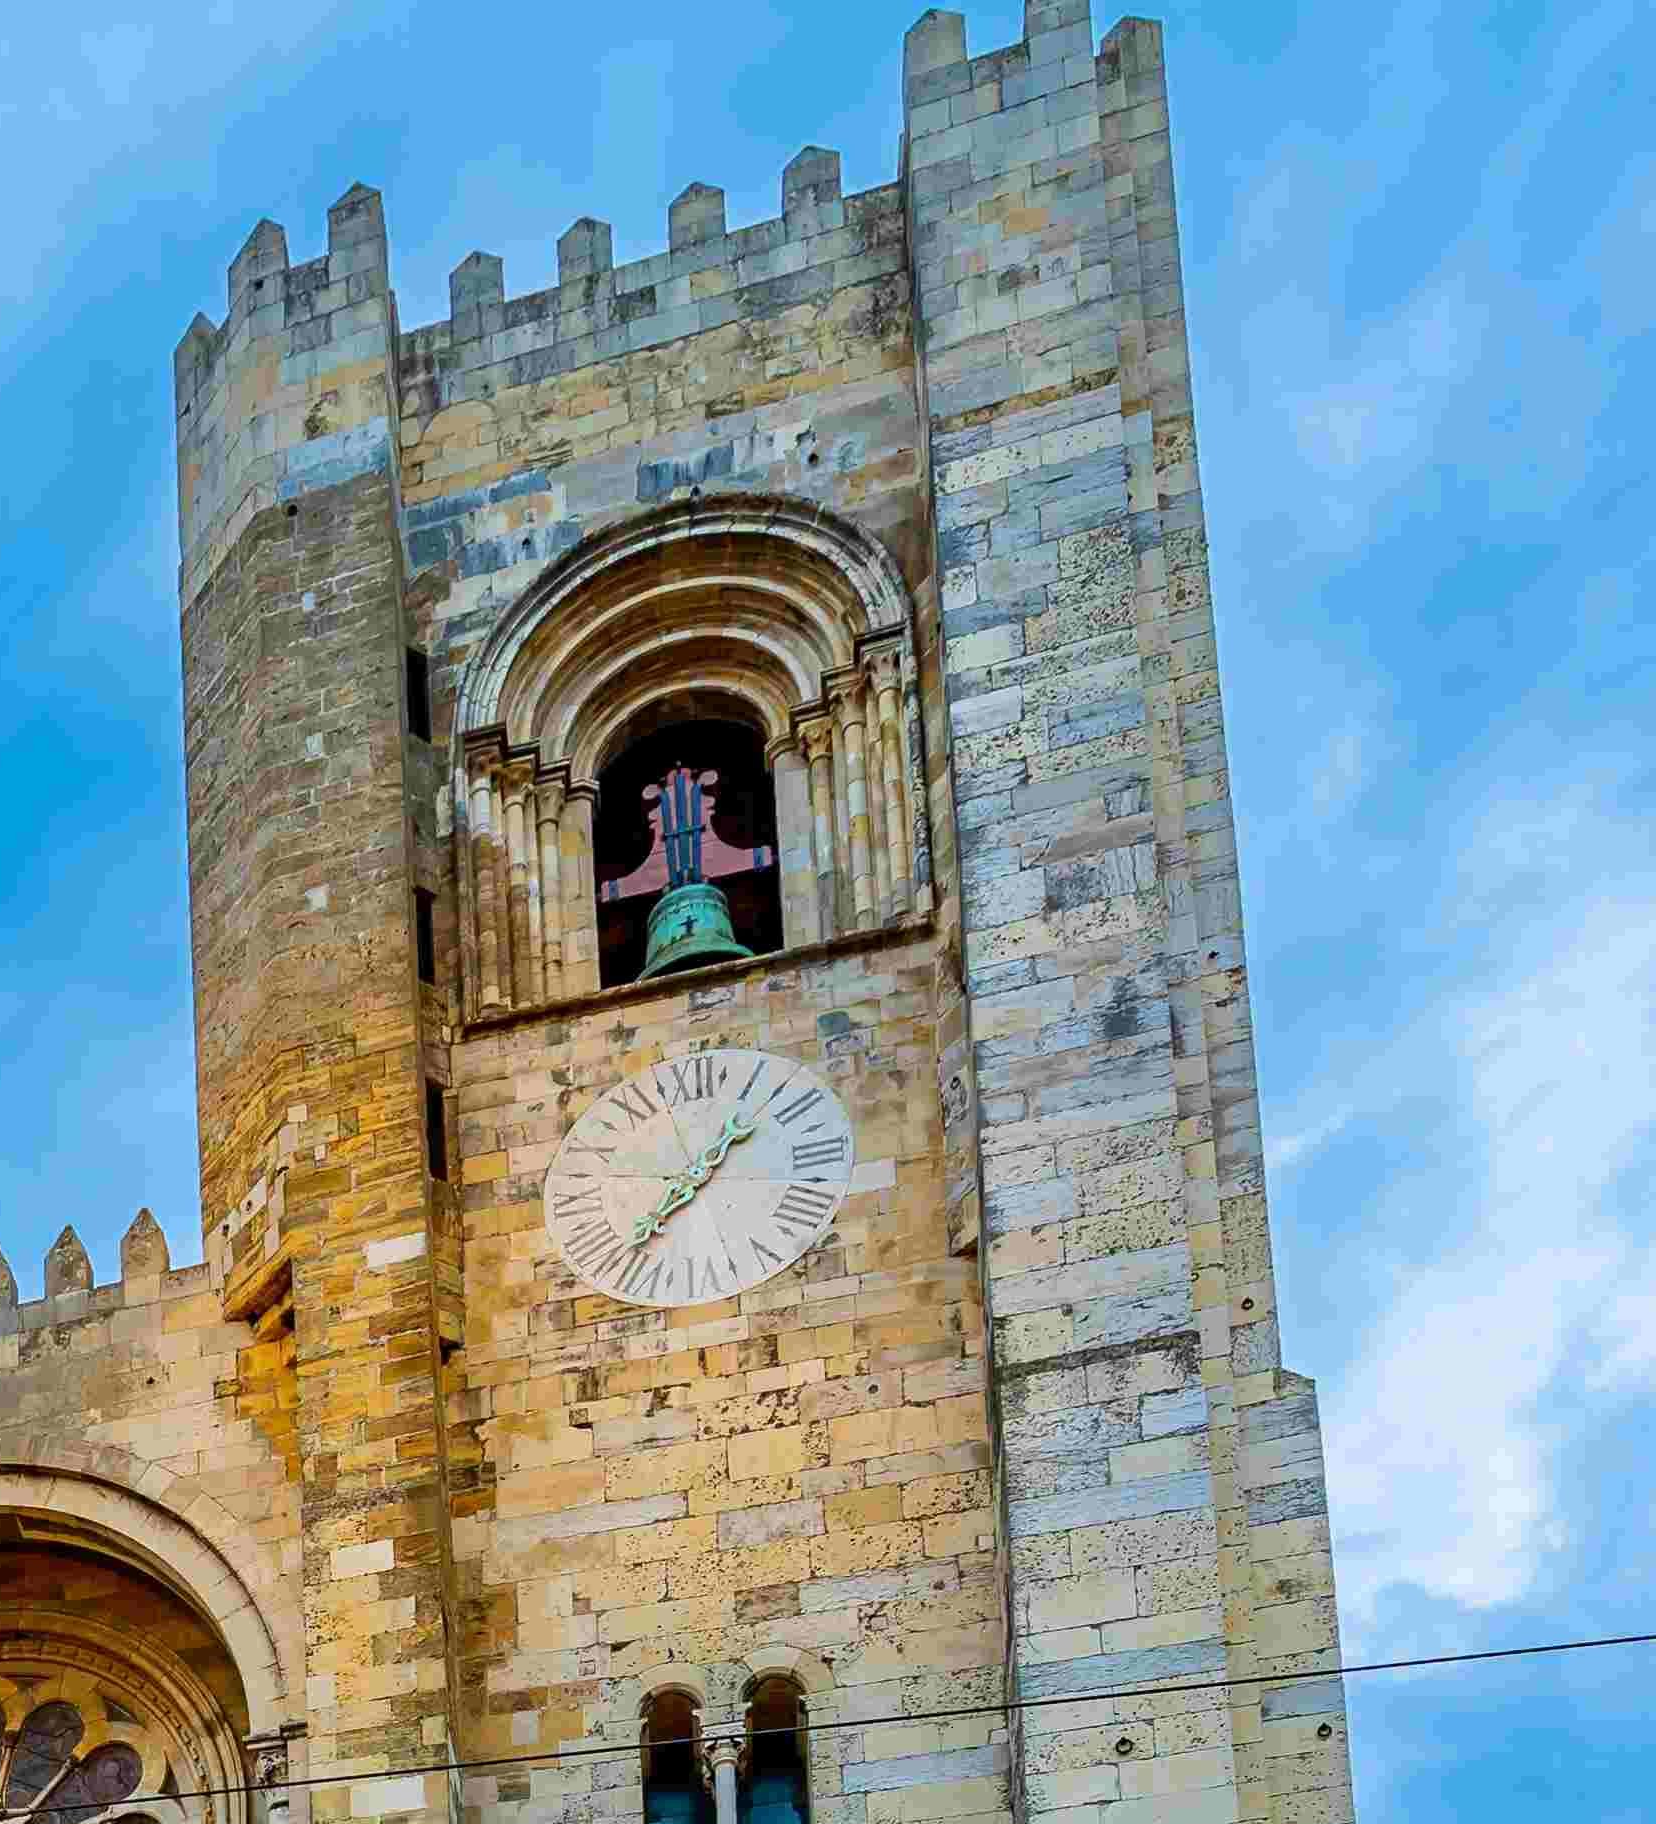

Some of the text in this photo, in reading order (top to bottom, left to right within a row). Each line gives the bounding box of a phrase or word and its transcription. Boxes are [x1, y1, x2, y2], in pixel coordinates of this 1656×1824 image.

[672, 1056, 714, 1104] XII
[738, 1060, 769, 1101] I
[609, 1083, 658, 1131] XI
[772, 1087, 824, 1127] II
[565, 1136, 616, 1164] X
[792, 1136, 849, 1171] III
[553, 1187, 602, 1219] IX
[611, 1246, 666, 1298] VII
[748, 1237, 785, 1275] V
[683, 1256, 726, 1298] VI
